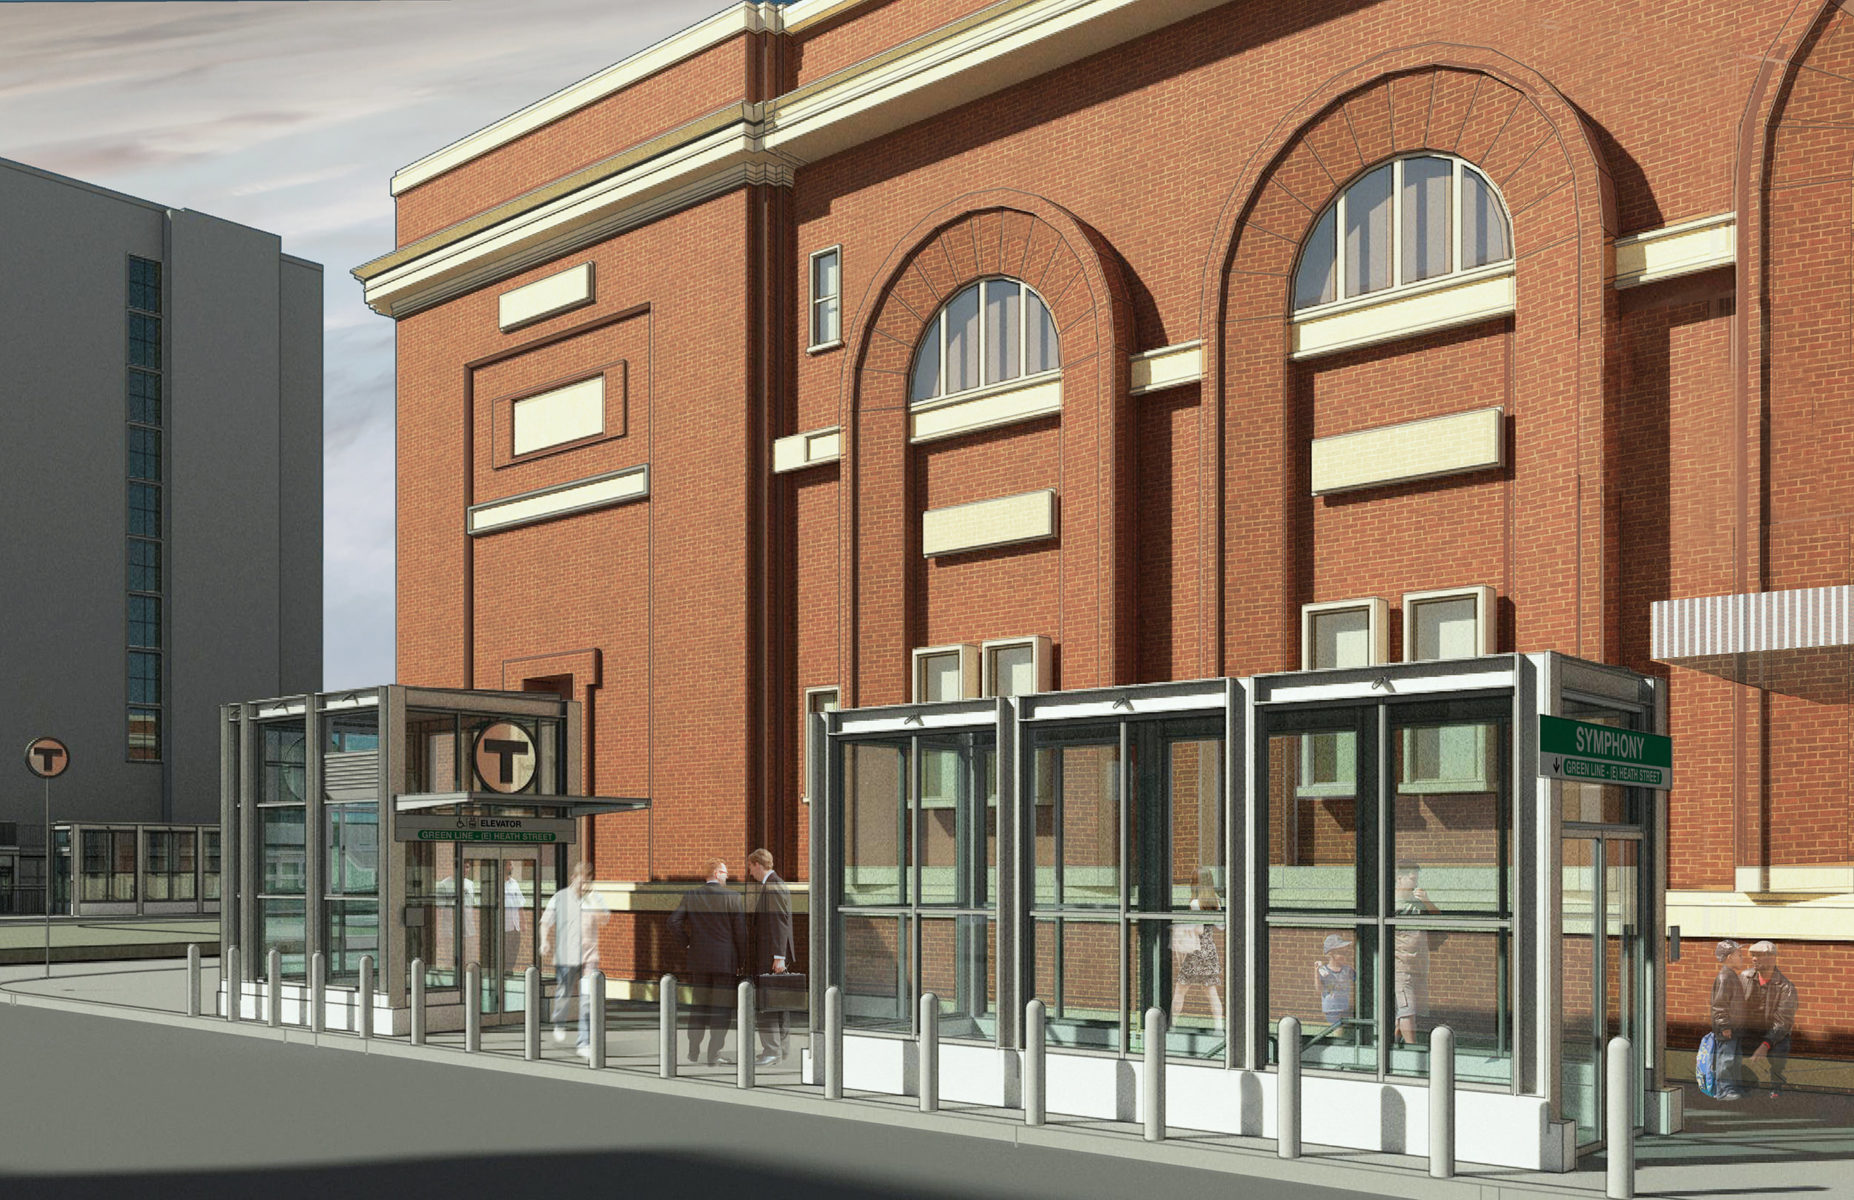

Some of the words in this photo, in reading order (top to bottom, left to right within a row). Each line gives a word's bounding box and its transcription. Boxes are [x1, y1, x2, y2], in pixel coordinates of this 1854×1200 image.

[1576, 726, 1644, 760] SYMPHONY
[33, 747, 63, 772] T
[484, 738, 528, 784] T
[1566, 760, 1590, 777] GREEN
[1590, 763, 1606, 777] LINE
[1610, 765, 1618, 781] (E)
[1620, 767, 1639, 781] HEATH
[1639, 769, 1661, 783] STREET
[421, 831, 453, 840] GREEN
[454, 831, 473, 840] LINE
[481, 832, 492, 840] (E)
[494, 832, 520, 840] HEATH
[522, 833, 553, 841] STREET
[480, 819, 521, 829] ELEVATOR
